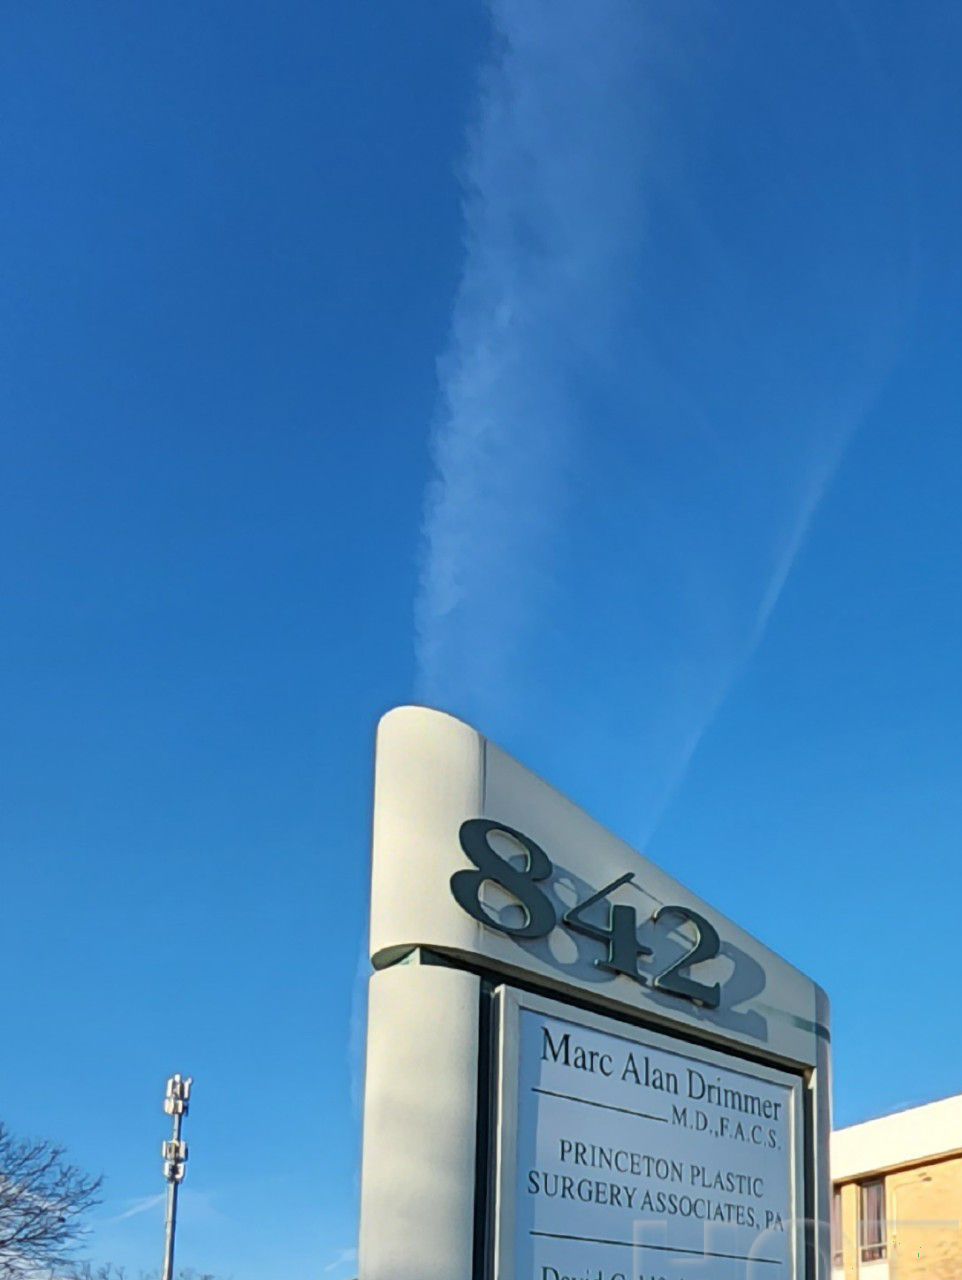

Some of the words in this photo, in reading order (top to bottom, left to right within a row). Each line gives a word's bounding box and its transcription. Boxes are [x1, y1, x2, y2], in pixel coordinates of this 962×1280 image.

[450, 818, 721, 1009] 842
[540, 1026, 613, 1077] Marc
[620, 1052, 679, 1095] Alan
[686, 1068, 782, 1122] Drimmer
[528, 1170, 637, 1208] SURGERY
[640, 1190, 760, 1230] ASSOCIATES,
[765, 1209, 784, 1233] PA
[559, 1139, 683, 1183] PRINCETON
[690, 1164, 764, 1199] PLASTIC
